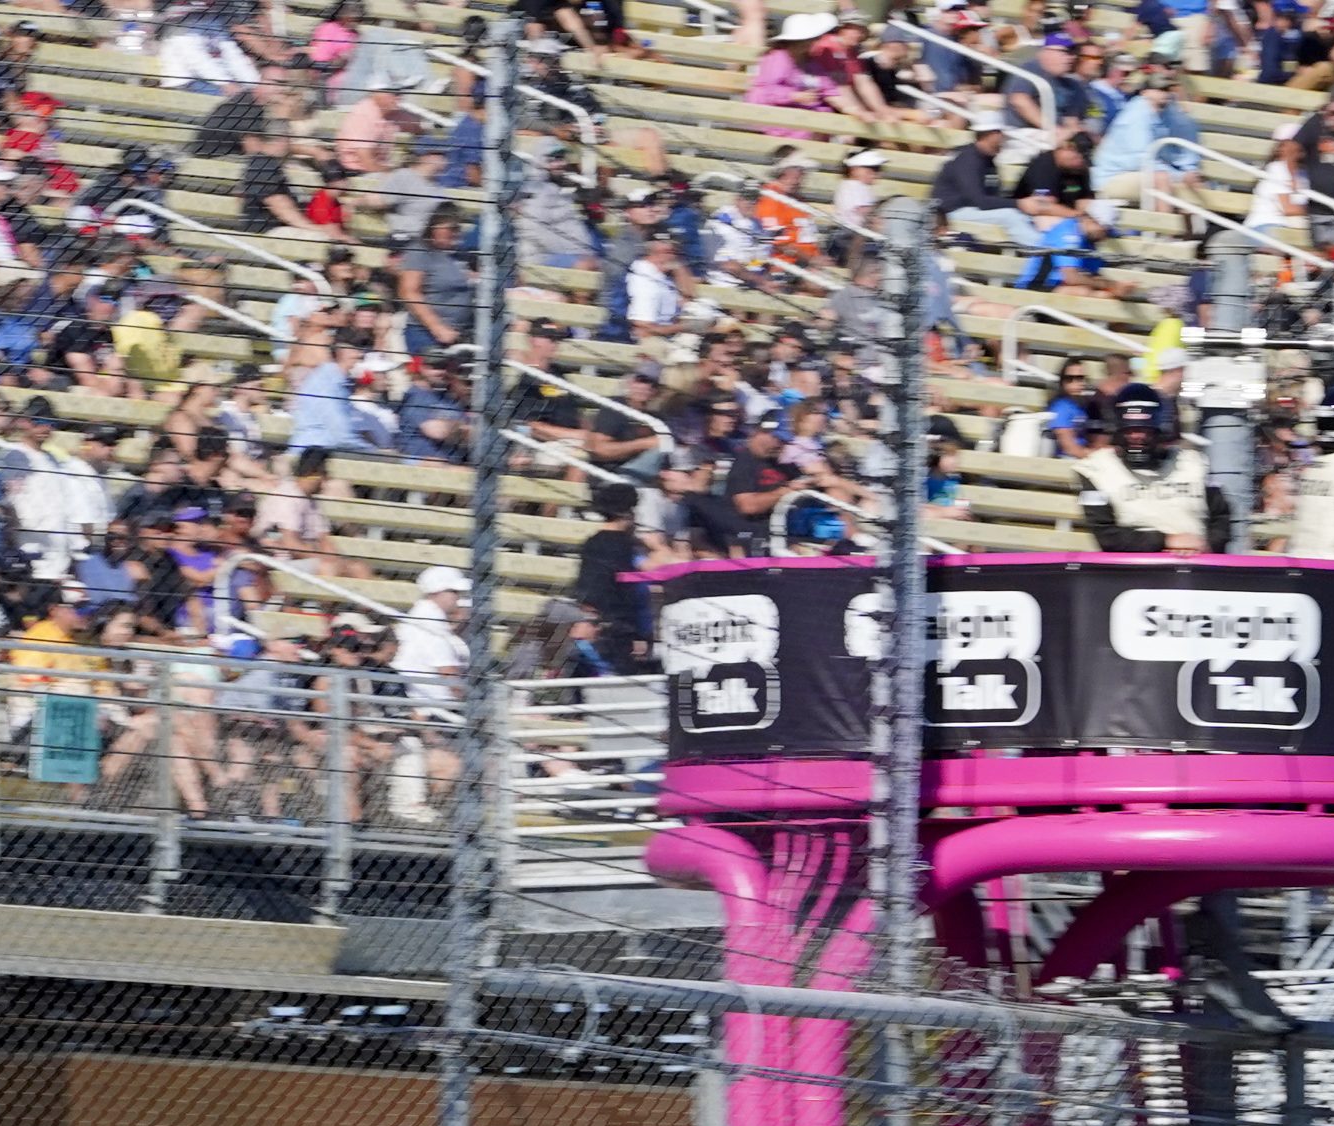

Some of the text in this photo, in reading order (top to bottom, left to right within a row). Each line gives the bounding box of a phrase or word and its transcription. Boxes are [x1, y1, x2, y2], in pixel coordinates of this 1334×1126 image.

[1143, 604, 1298, 649] Straight
[693, 677, 760, 715] Talk
[937, 673, 1019, 711] Talk
[1208, 676, 1301, 713] Talk
